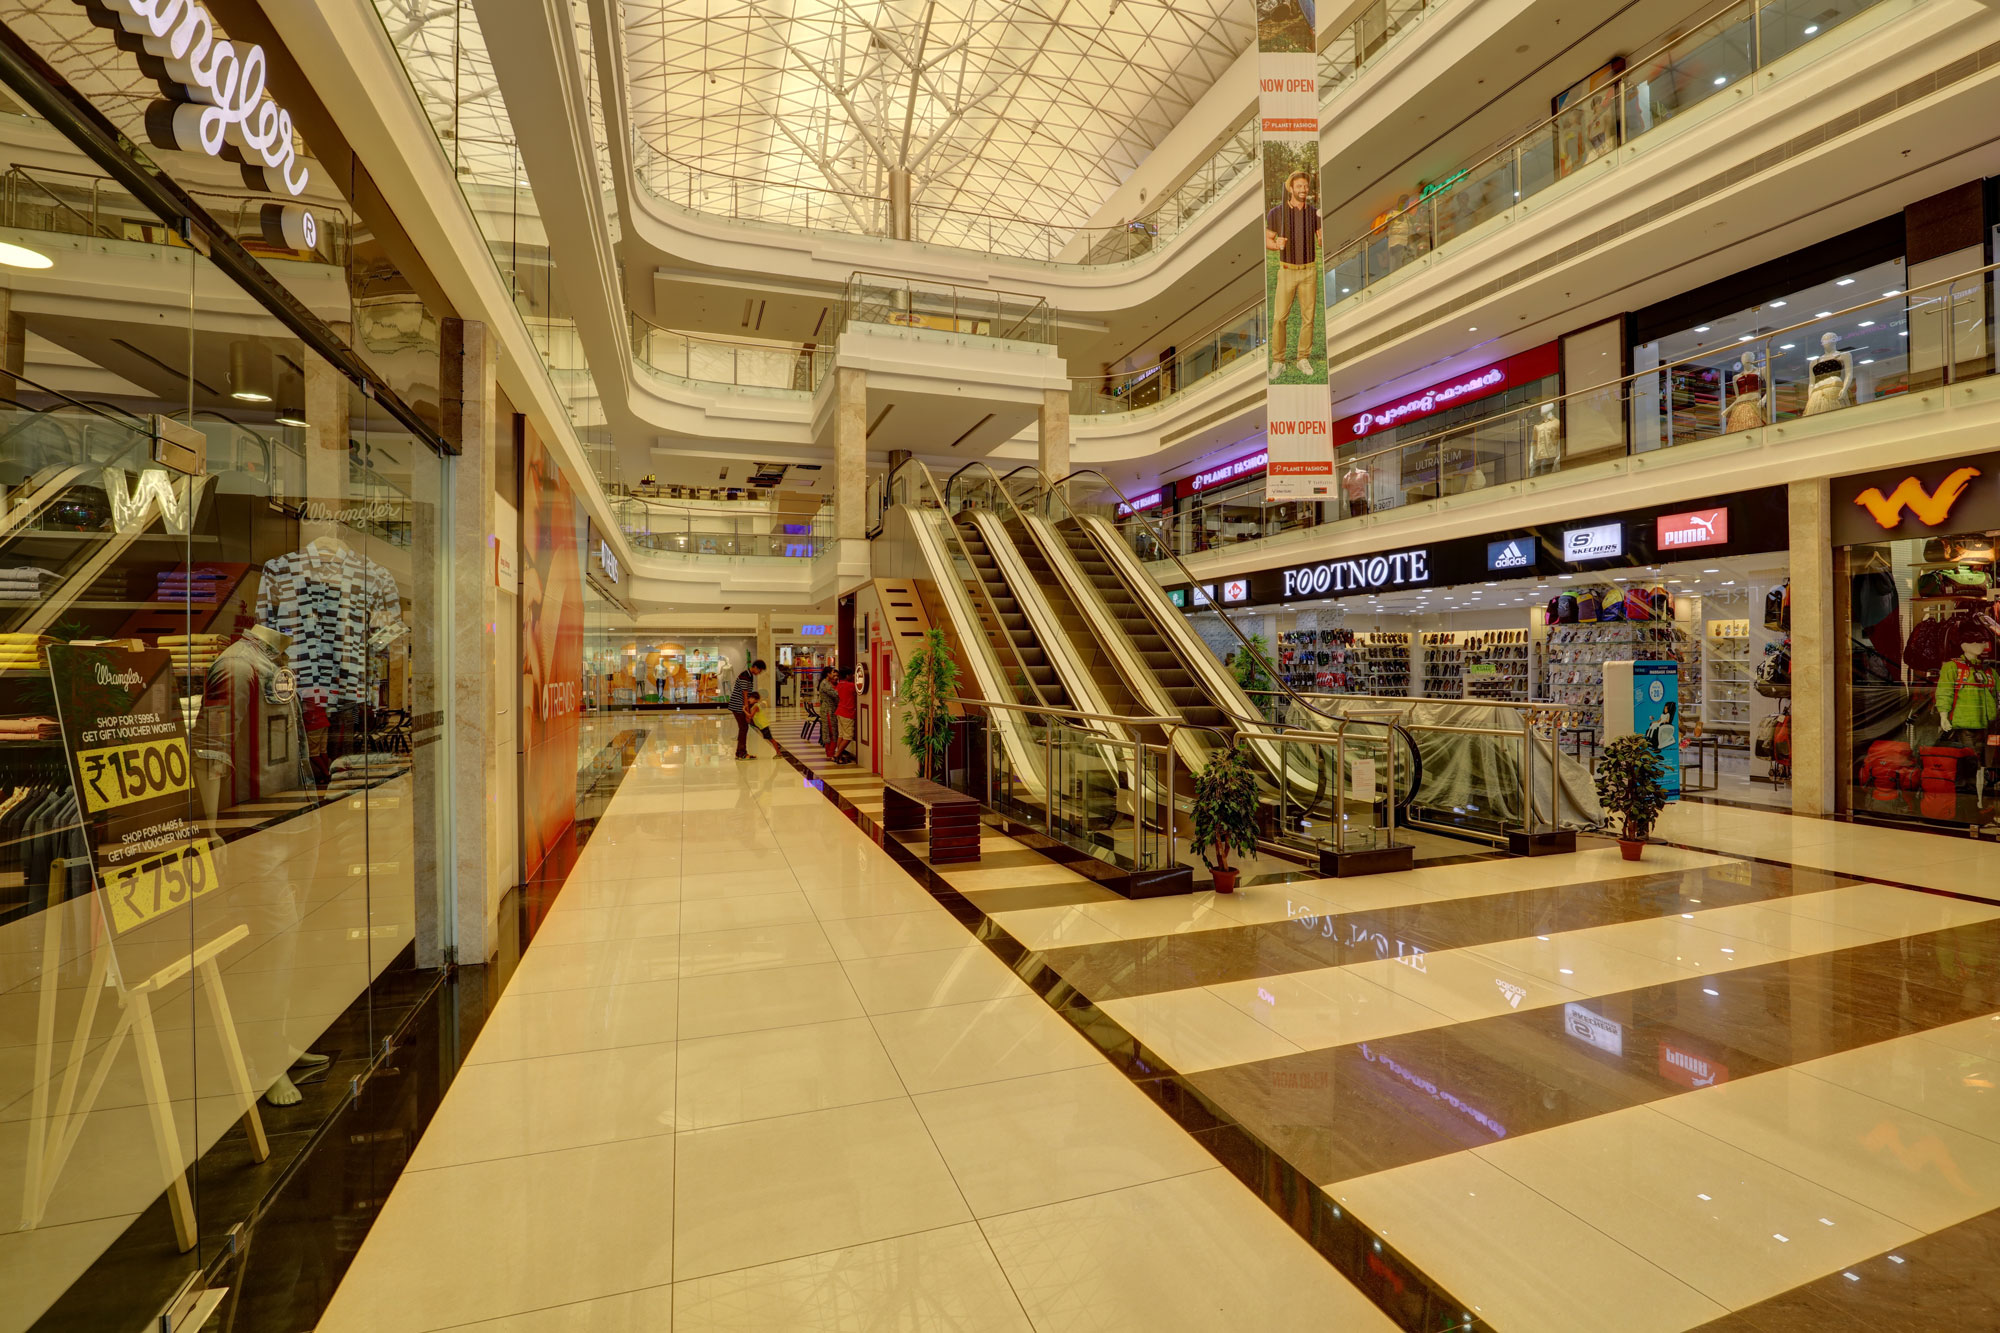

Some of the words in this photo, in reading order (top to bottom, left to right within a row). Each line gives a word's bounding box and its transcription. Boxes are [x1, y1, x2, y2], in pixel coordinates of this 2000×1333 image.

[1260, 79, 1284, 93] NOW
[1286, 79, 1314, 93] OPEN
[1270, 421, 1296, 435] NOW
[1298, 421, 1326, 435] OPEN
[1203, 465, 1233, 485] PLANET
[297, 501, 400, 528] Wrangler
[1665, 528, 1707, 545] PUMA
[1572, 544, 1618, 556] SKECHERS
[1495, 555, 1527, 568] adidas
[1283, 550, 1429, 597] FOOTNOTE
[801, 625, 833, 636] max
[95, 662, 144, 692] Wrangler
[549, 681, 576, 719] TRENDS
[97, 715, 118, 728] SHOP
[118, 714, 135, 726] FOR
[154, 713, 161, 722] &
[82, 730, 98, 743] GET
[99, 728, 117, 741] GIFT
[117, 725, 152, 738] VOUCHER
[151, 722, 177, 734] WORTH
[84, 743, 187, 803] ₹1500
[121, 831, 143, 845] SHOP
[142, 827, 158, 839] FOR
[178, 818, 184, 828] &
[108, 848, 124, 863] GET
[124, 843, 142, 857] GIFT
[141, 832, 175, 852] VOUCHER
[174, 824, 200, 841] WORTH
